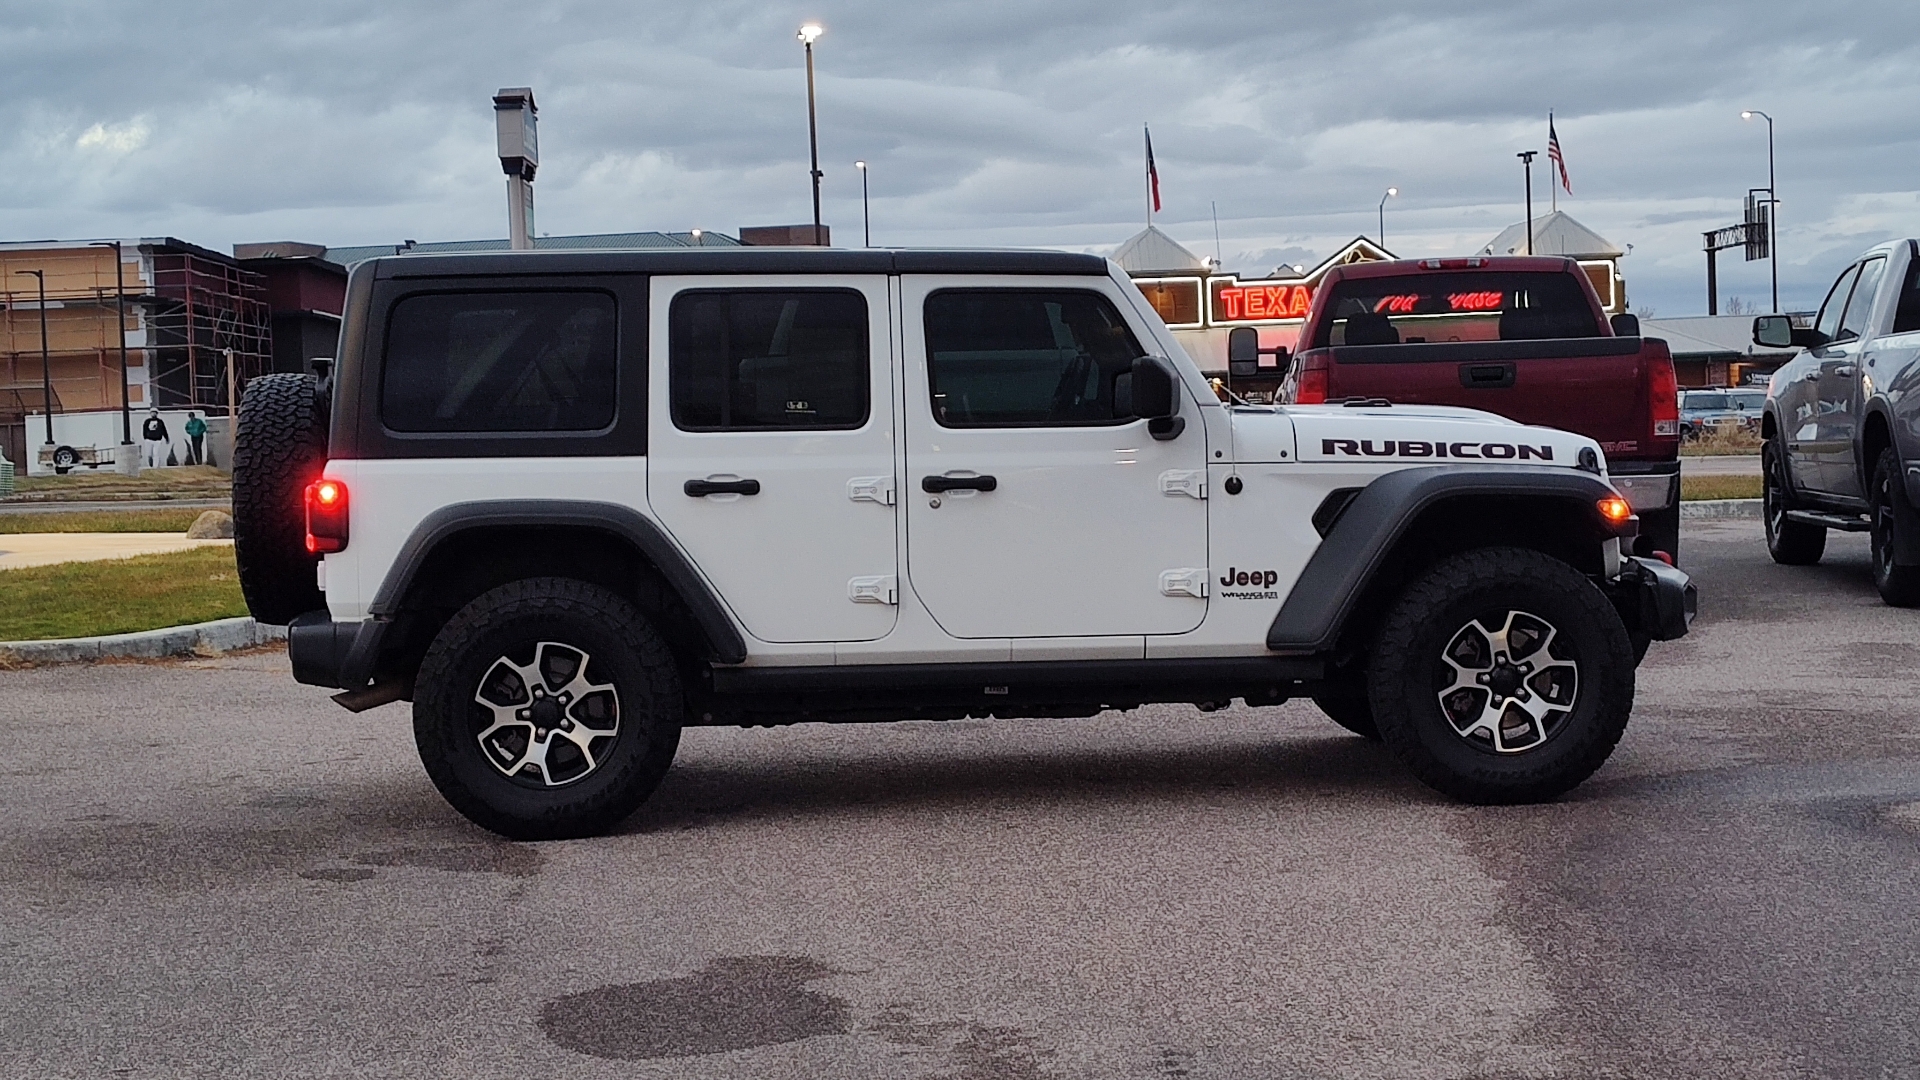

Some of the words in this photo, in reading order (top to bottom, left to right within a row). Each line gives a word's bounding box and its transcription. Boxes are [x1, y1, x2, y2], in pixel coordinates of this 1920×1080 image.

[1220, 286, 1318, 318] TEXA
[1322, 438, 1554, 461] RUBICON
[1220, 566, 1278, 589] Jeep
